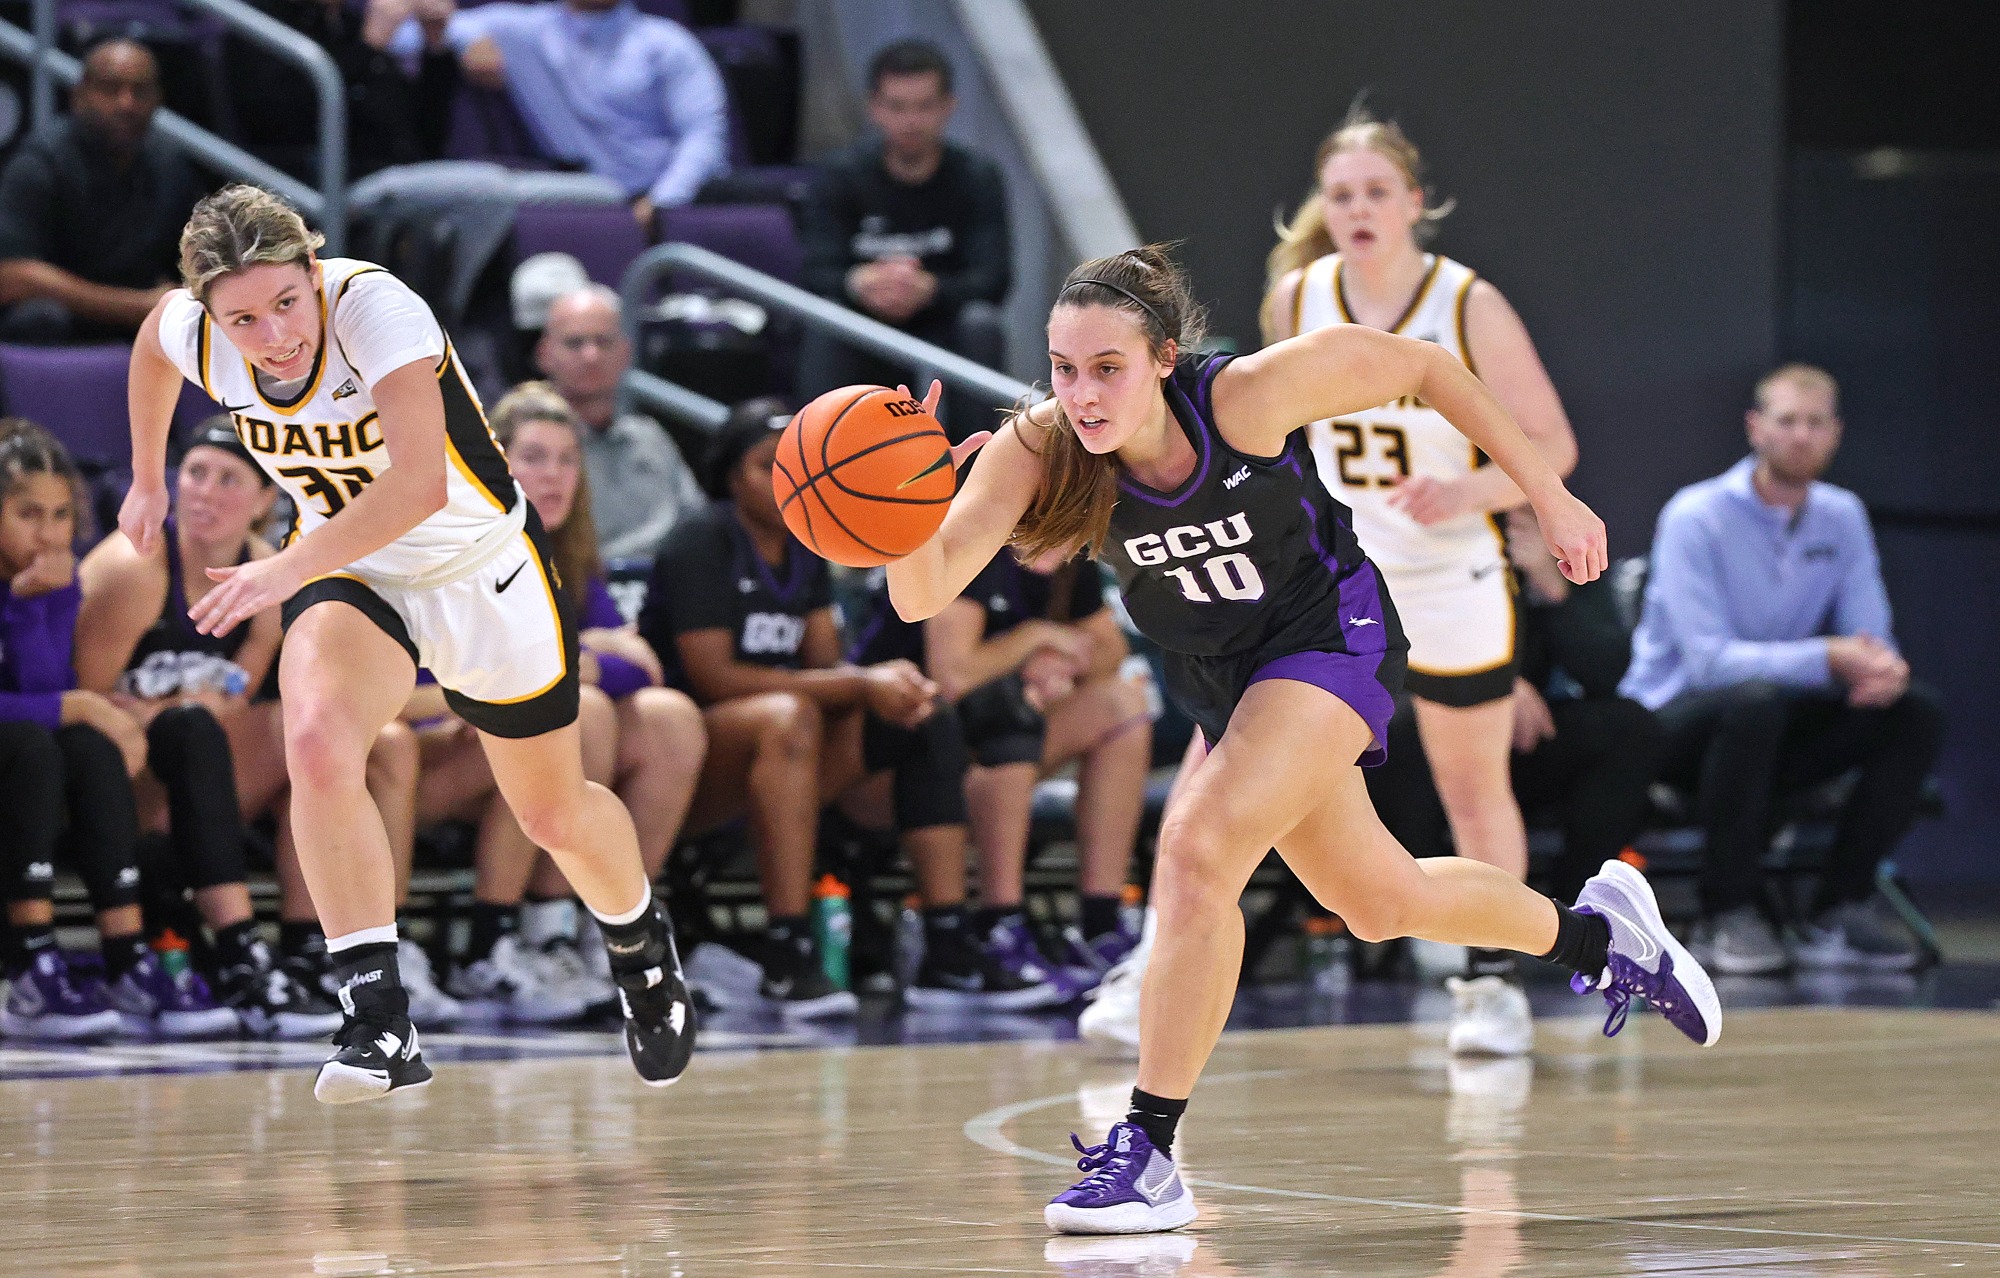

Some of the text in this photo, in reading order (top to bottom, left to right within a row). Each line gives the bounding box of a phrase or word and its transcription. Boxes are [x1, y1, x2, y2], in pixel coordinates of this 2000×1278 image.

[1222, 464, 1252, 490] WAC
[1332, 421, 1411, 487] 23
[1124, 512, 1254, 566] GCU
[1164, 552, 1265, 603] 10
